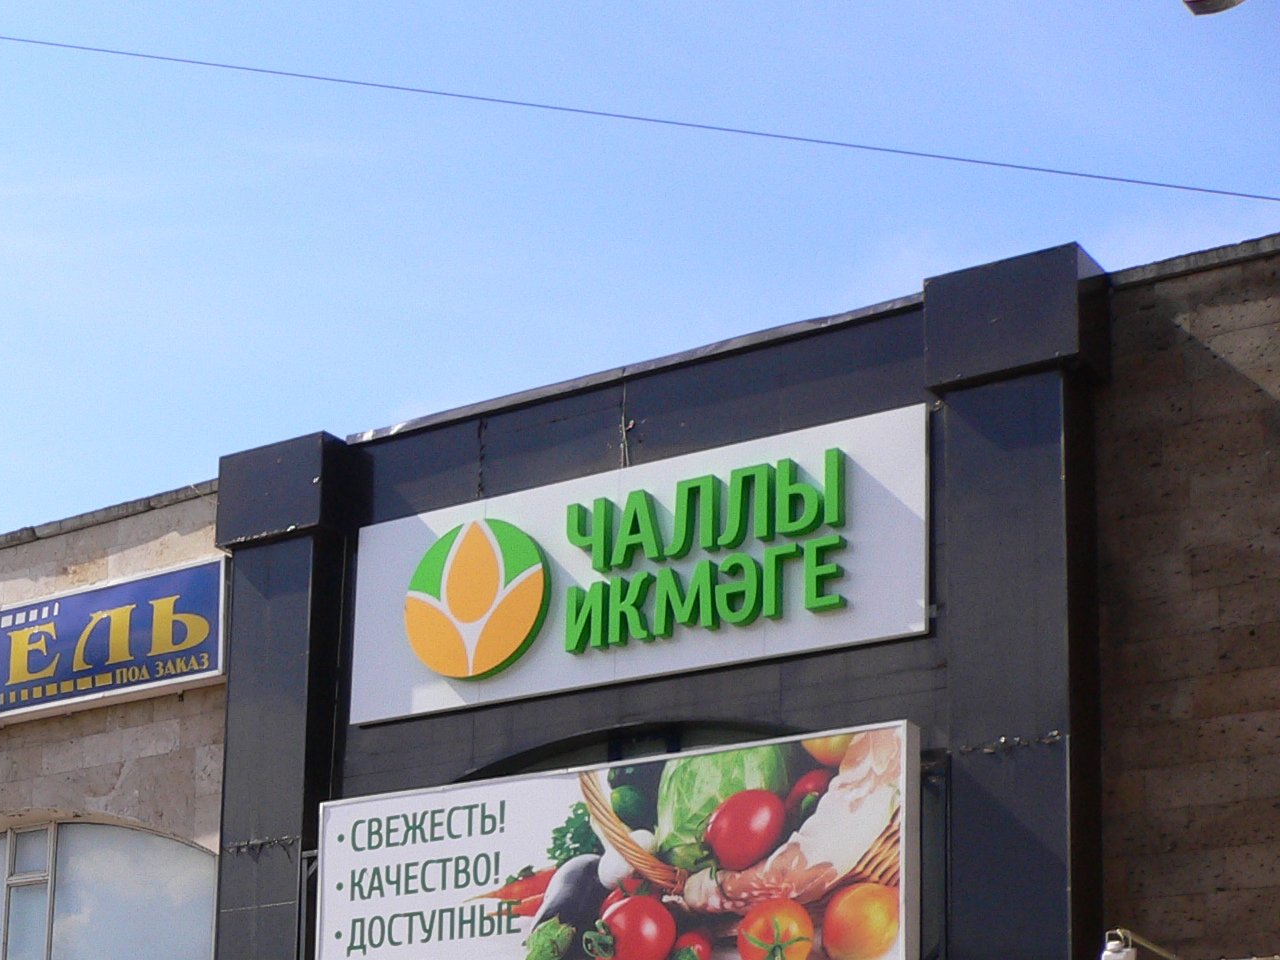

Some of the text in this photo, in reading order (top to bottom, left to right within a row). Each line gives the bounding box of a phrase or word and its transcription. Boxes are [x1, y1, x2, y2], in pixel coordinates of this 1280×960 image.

[566, 447, 847, 573] ЧАЛЛЫ
[565, 534, 847, 655] ИКМӘГЕ
[115, 652, 210, 685] ПОД ЗАКАЗ
[350, 800, 506, 852] СВЕЖЕСТЬ!
[349, 852, 501, 901] КАЧЕСТВО!
[346, 901, 521, 955] ДОСТУПНЫЕ
